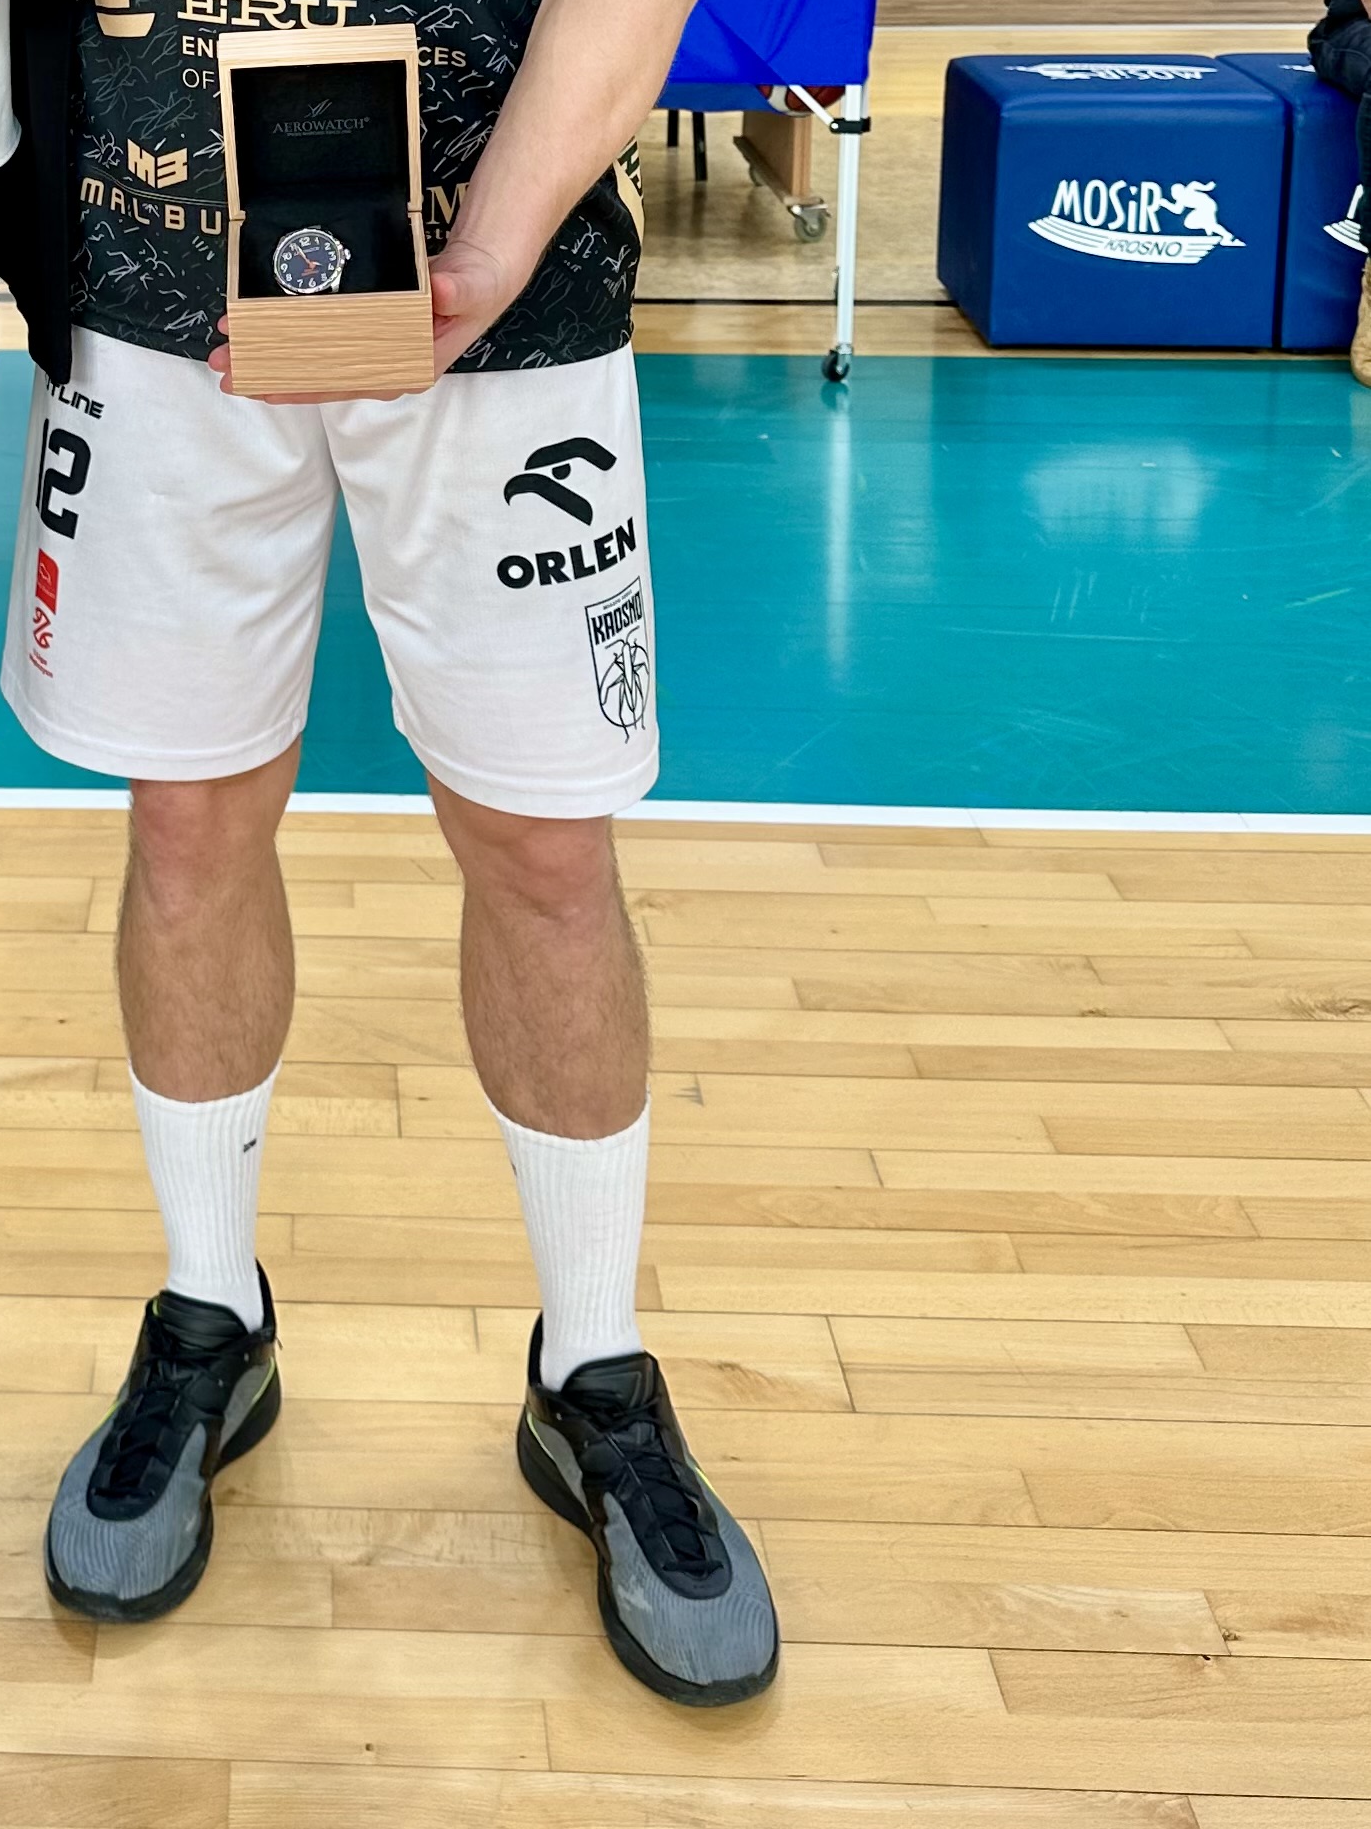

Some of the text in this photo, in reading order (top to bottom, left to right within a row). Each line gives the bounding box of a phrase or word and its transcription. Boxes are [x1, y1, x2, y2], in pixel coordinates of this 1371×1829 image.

[182, 68, 216, 89] OF
[1051, 179, 1161, 233] MOSiR
[1104, 239, 1183, 257] KROSNO
[35, 417, 92, 540] 12
[496, 516, 637, 589] ORLEN
[591, 591, 642, 646] KROSNO
